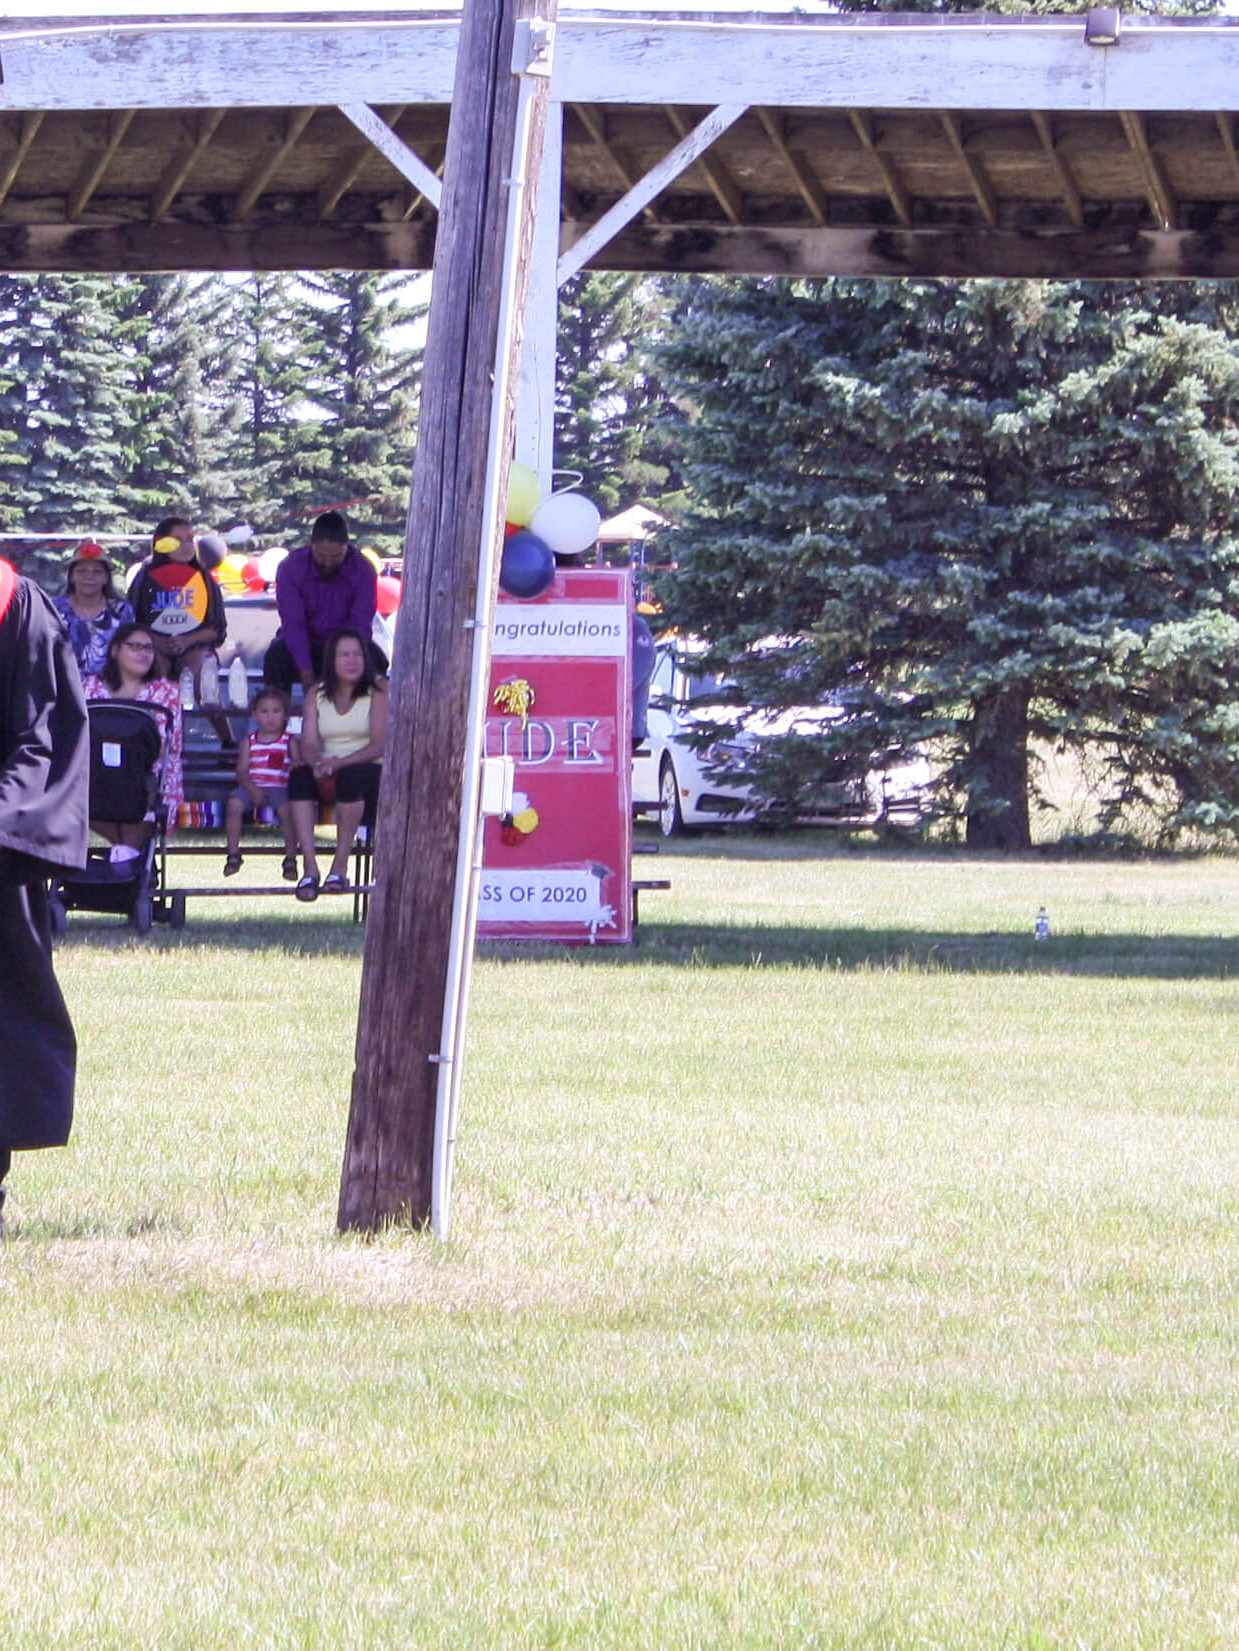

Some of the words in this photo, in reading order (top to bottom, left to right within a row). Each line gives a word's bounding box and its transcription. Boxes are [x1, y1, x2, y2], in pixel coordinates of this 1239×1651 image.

[494, 620, 622, 639] ngratulations
[483, 719, 605, 766] UDE
[509, 886, 535, 902] OF
[541, 887, 587, 903] 2020
